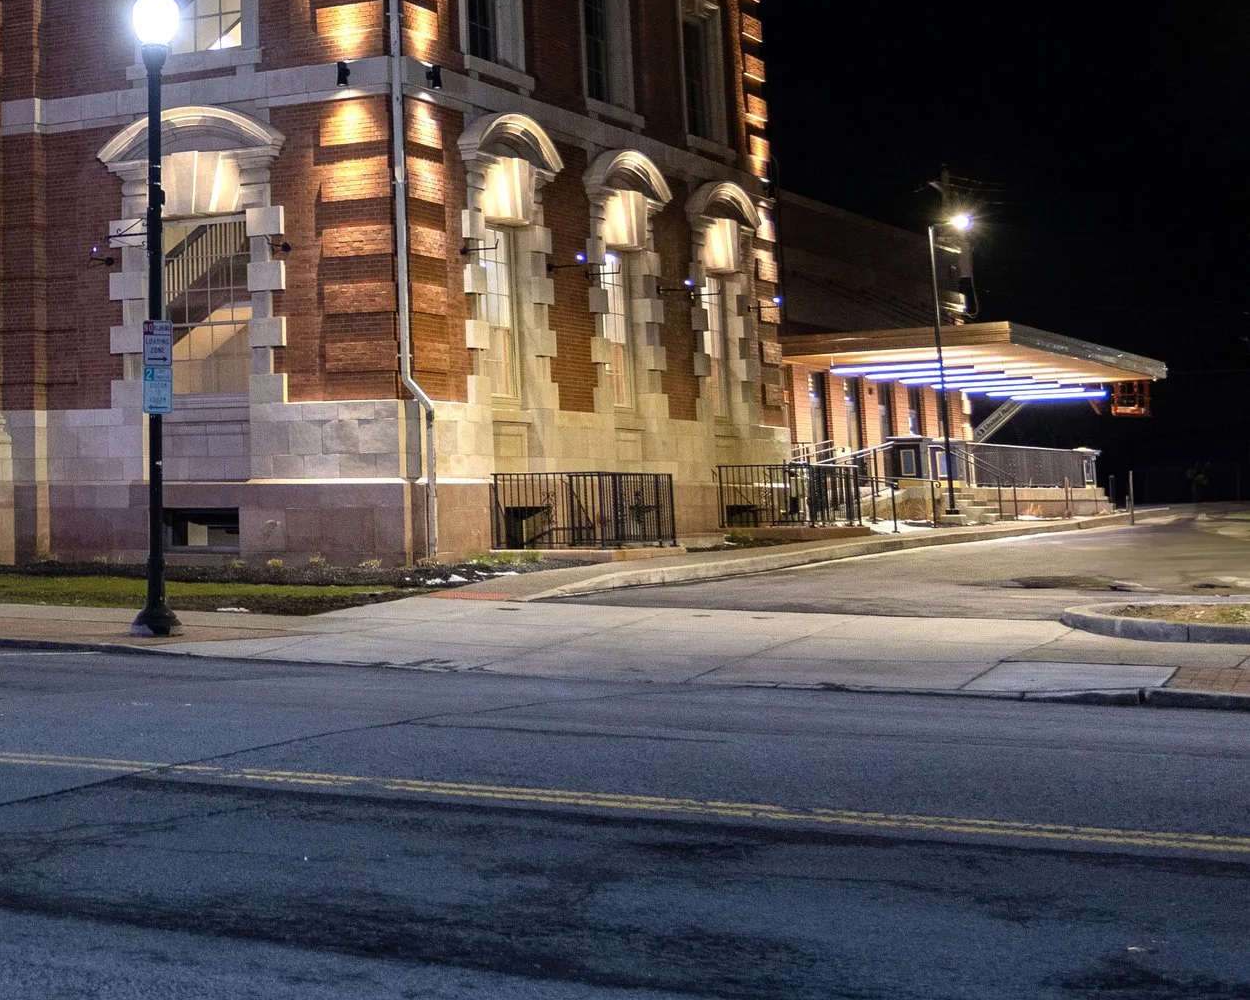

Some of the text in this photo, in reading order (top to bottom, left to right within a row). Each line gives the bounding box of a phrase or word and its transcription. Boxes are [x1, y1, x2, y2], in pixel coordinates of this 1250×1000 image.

[143, 323, 153, 333] NO
[146, 369, 153, 380] 2
[983, 414, 1002, 430] United
